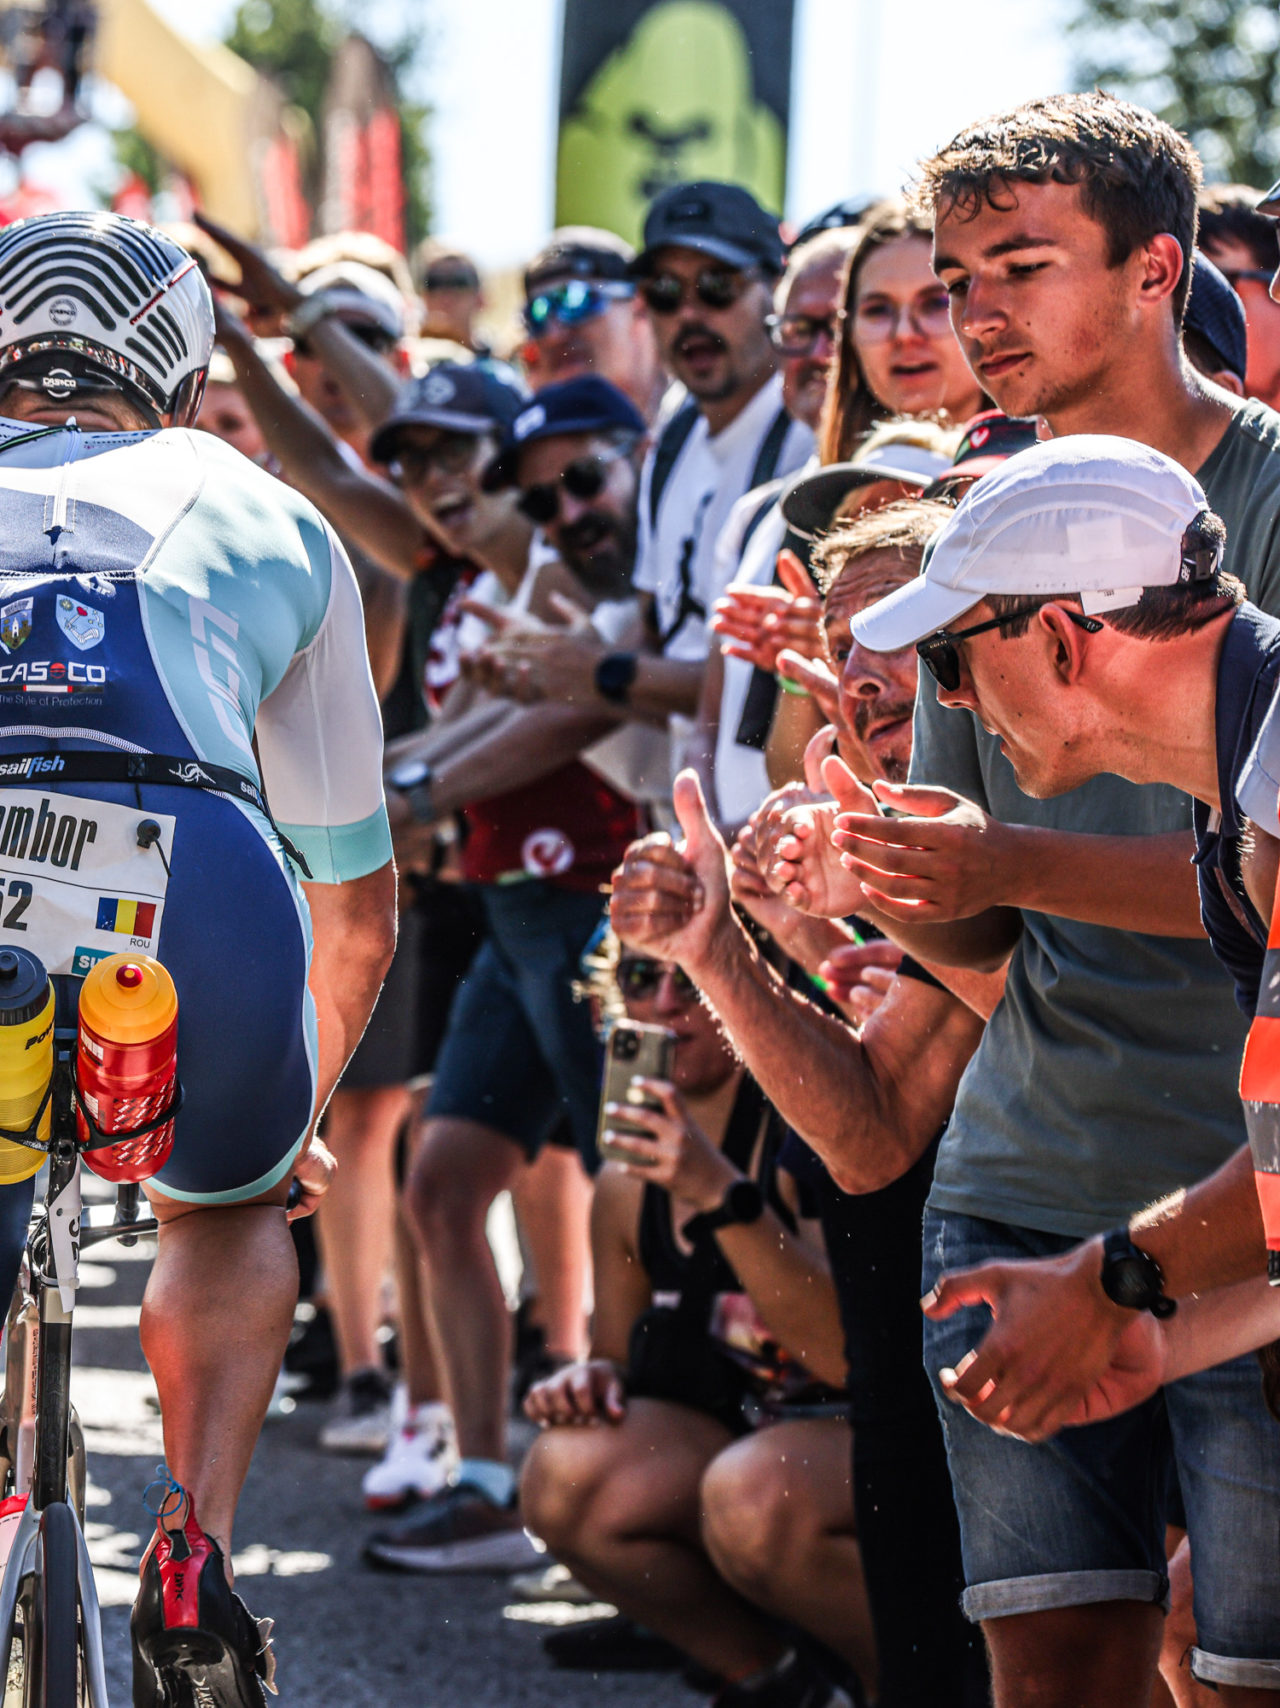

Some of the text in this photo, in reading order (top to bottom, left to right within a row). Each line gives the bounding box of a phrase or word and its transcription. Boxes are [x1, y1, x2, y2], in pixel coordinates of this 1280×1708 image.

[15, 694, 37, 706] Style
[39, 695, 49, 706] of
[51, 695, 103, 707] Protection
[129, 937, 151, 949] ROU
